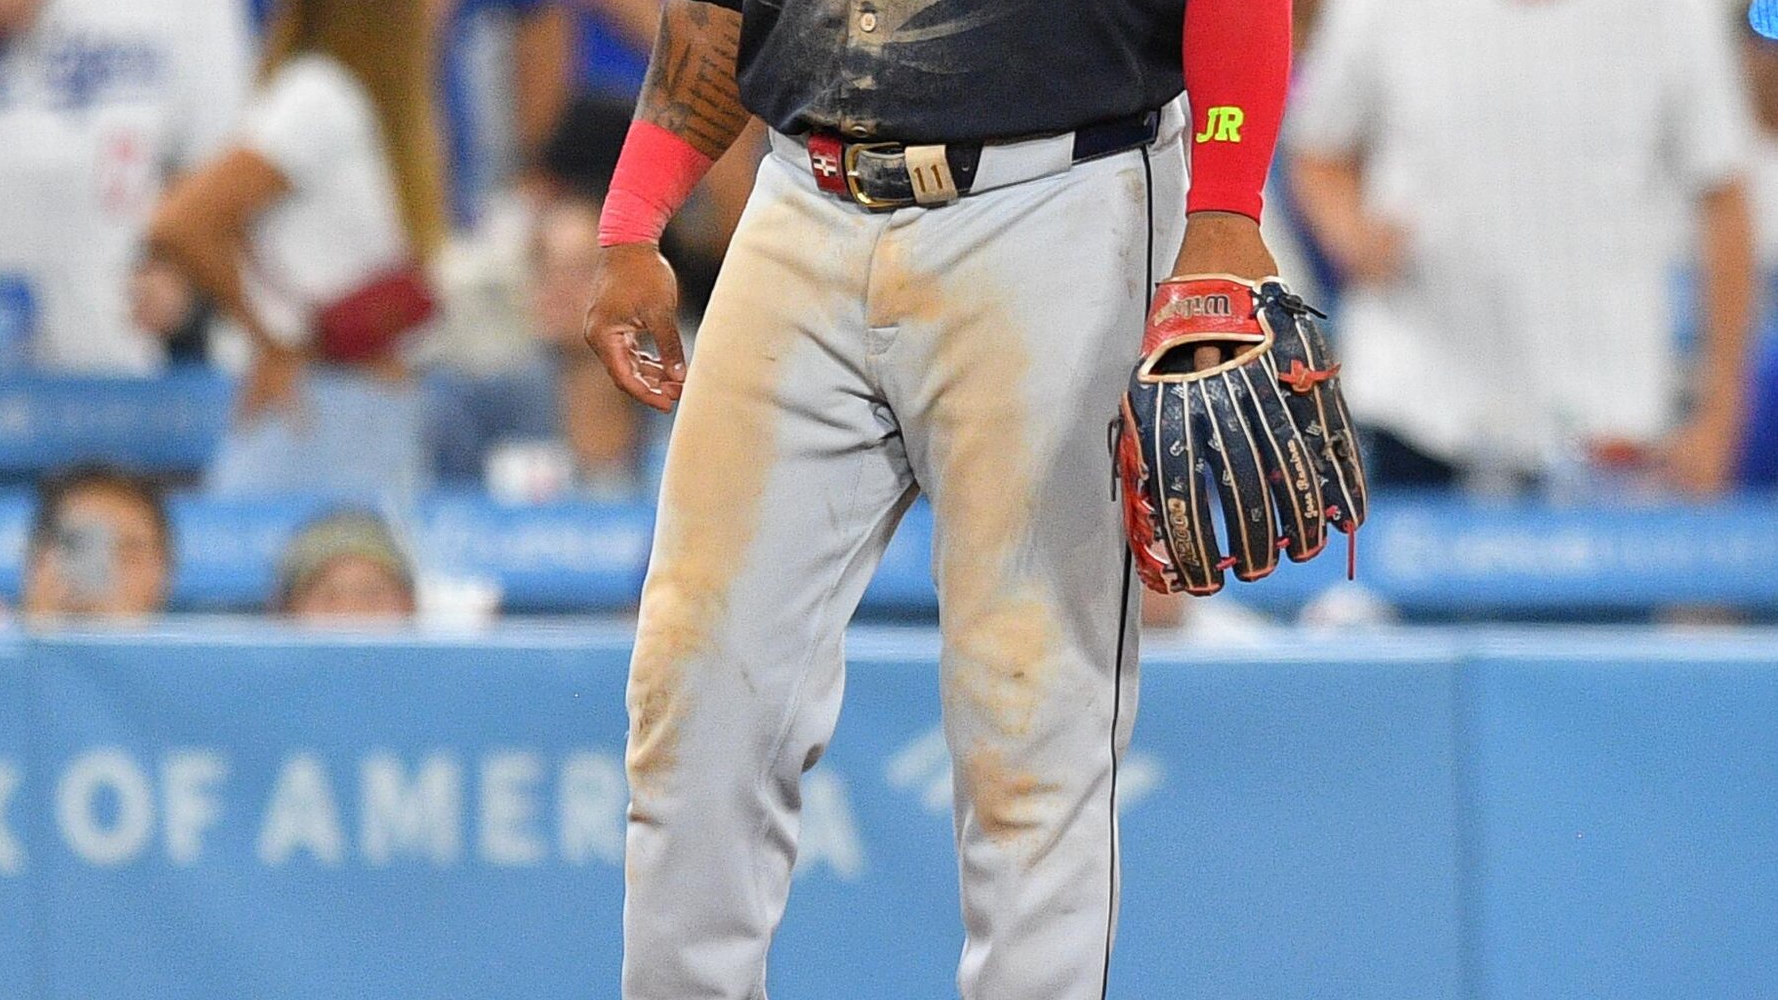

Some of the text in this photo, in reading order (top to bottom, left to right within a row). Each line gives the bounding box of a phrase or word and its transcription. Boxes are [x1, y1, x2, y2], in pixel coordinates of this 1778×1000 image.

[1196, 107, 1244, 143] JR
[913, 164, 944, 193] 11
[55, 748, 226, 866] OF
[257, 752, 867, 880] AMERA
